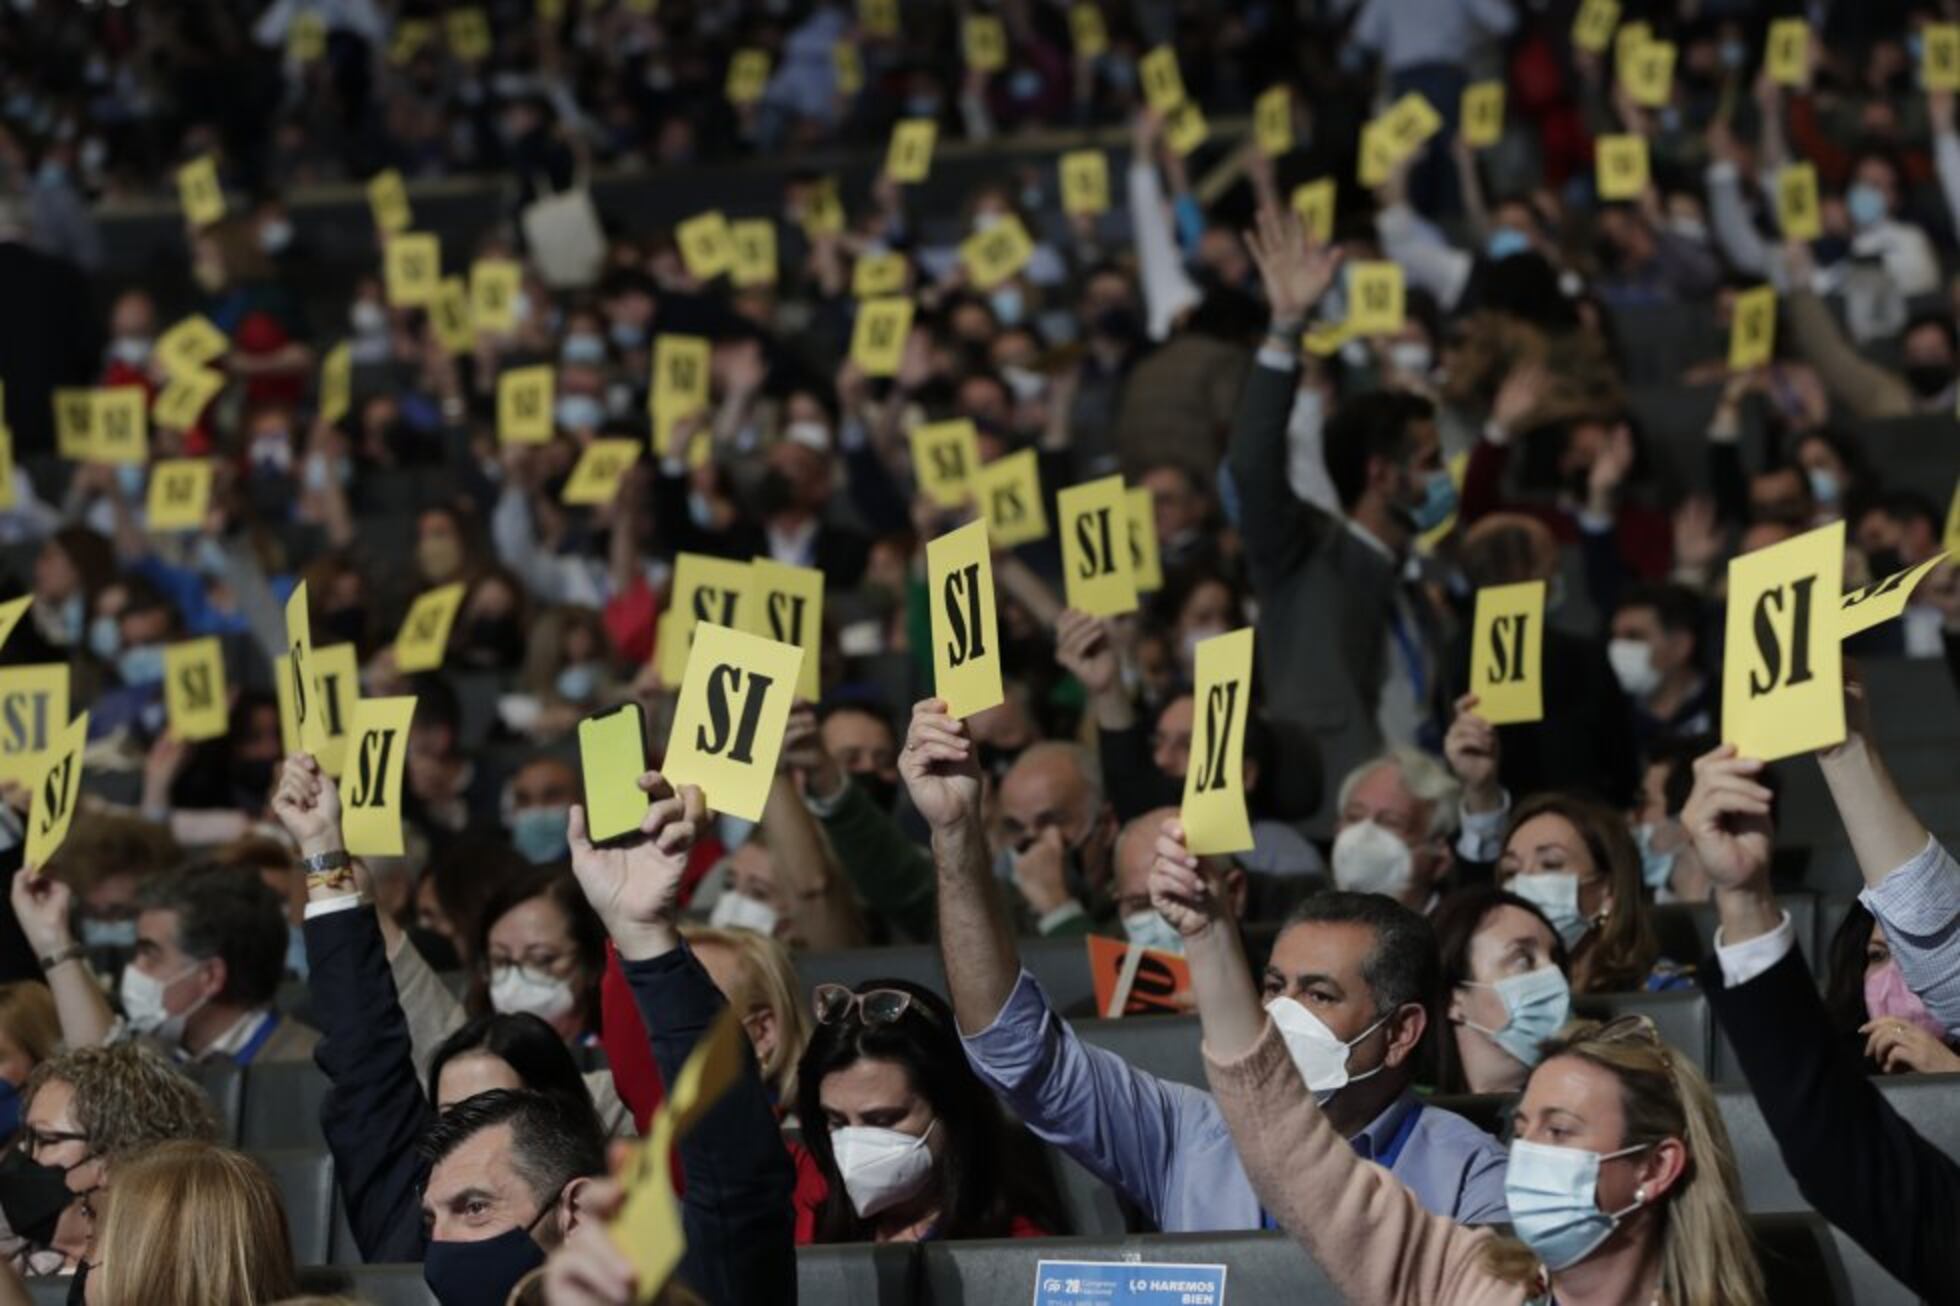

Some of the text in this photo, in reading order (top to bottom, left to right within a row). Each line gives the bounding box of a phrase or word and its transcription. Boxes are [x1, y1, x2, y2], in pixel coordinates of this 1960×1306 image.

[1076, 507, 1116, 580] SI
[944, 563, 986, 668] SI
[1488, 613, 1529, 684] SI
[1749, 574, 1818, 700] SI
[4, 691, 51, 754] SI
[695, 663, 774, 765] SI
[1195, 680, 1239, 795] SI
[40, 748, 76, 837] SI
[351, 728, 397, 809] SI
[1149, 1280, 1215, 1293] HAREMOS
[1182, 1293, 1215, 1305] BIEN
